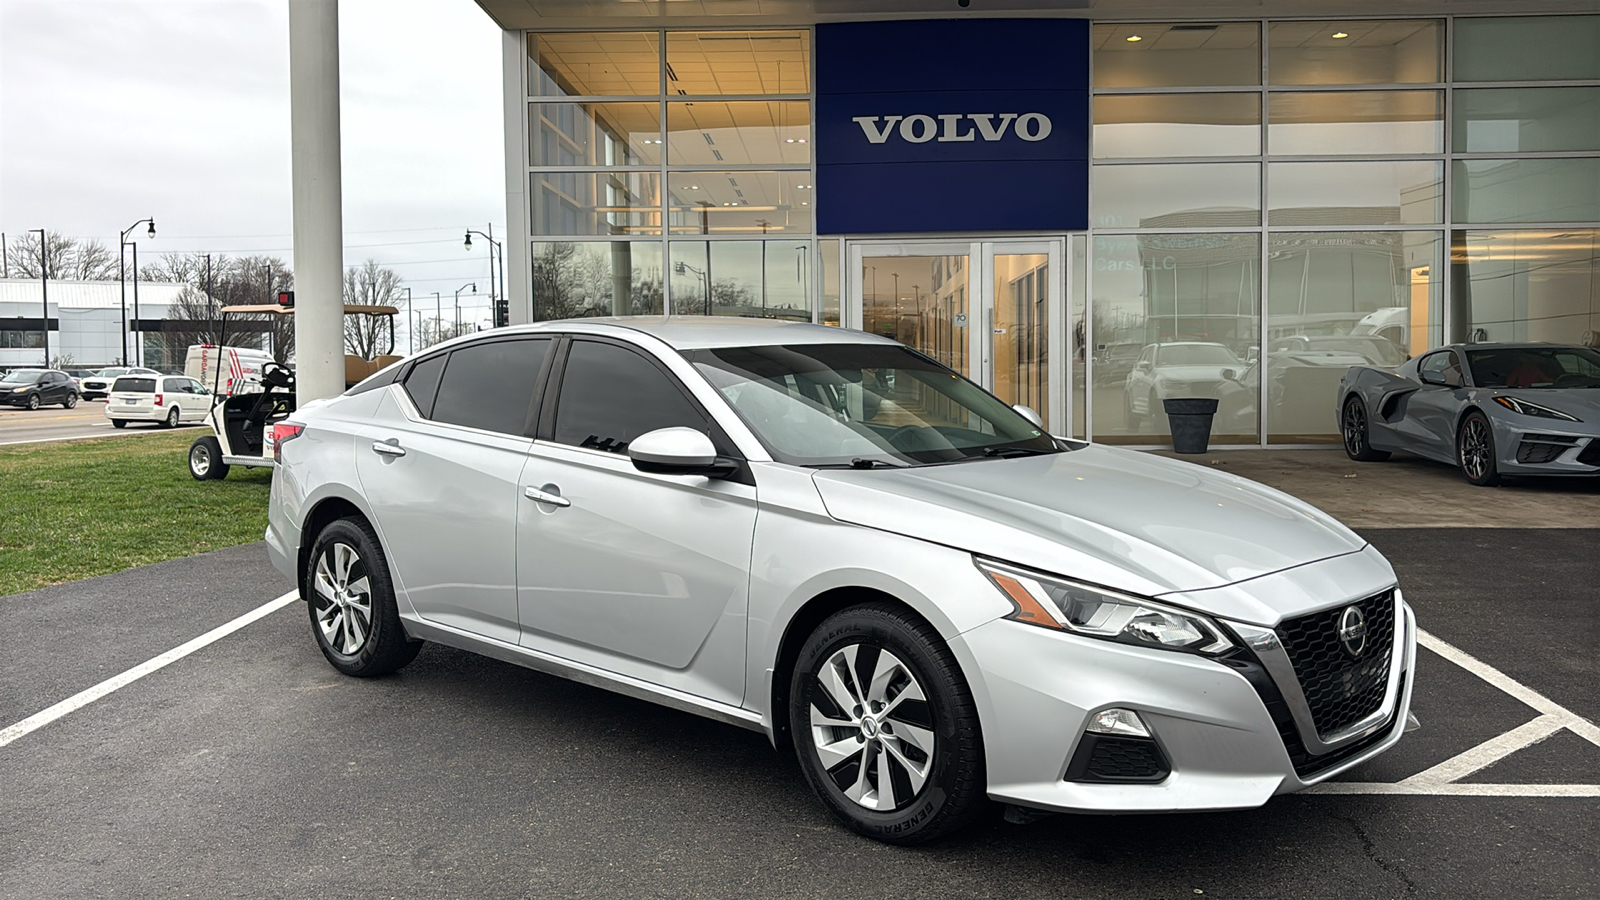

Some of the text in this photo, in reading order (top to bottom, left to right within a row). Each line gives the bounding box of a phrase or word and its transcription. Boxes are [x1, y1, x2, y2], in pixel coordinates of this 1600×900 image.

[852, 112, 1052, 143] VOLVO
[1095, 255, 1176, 272] Cars LLC
[809, 623, 861, 659] GENERAL
[873, 800, 935, 834] GENERAL
